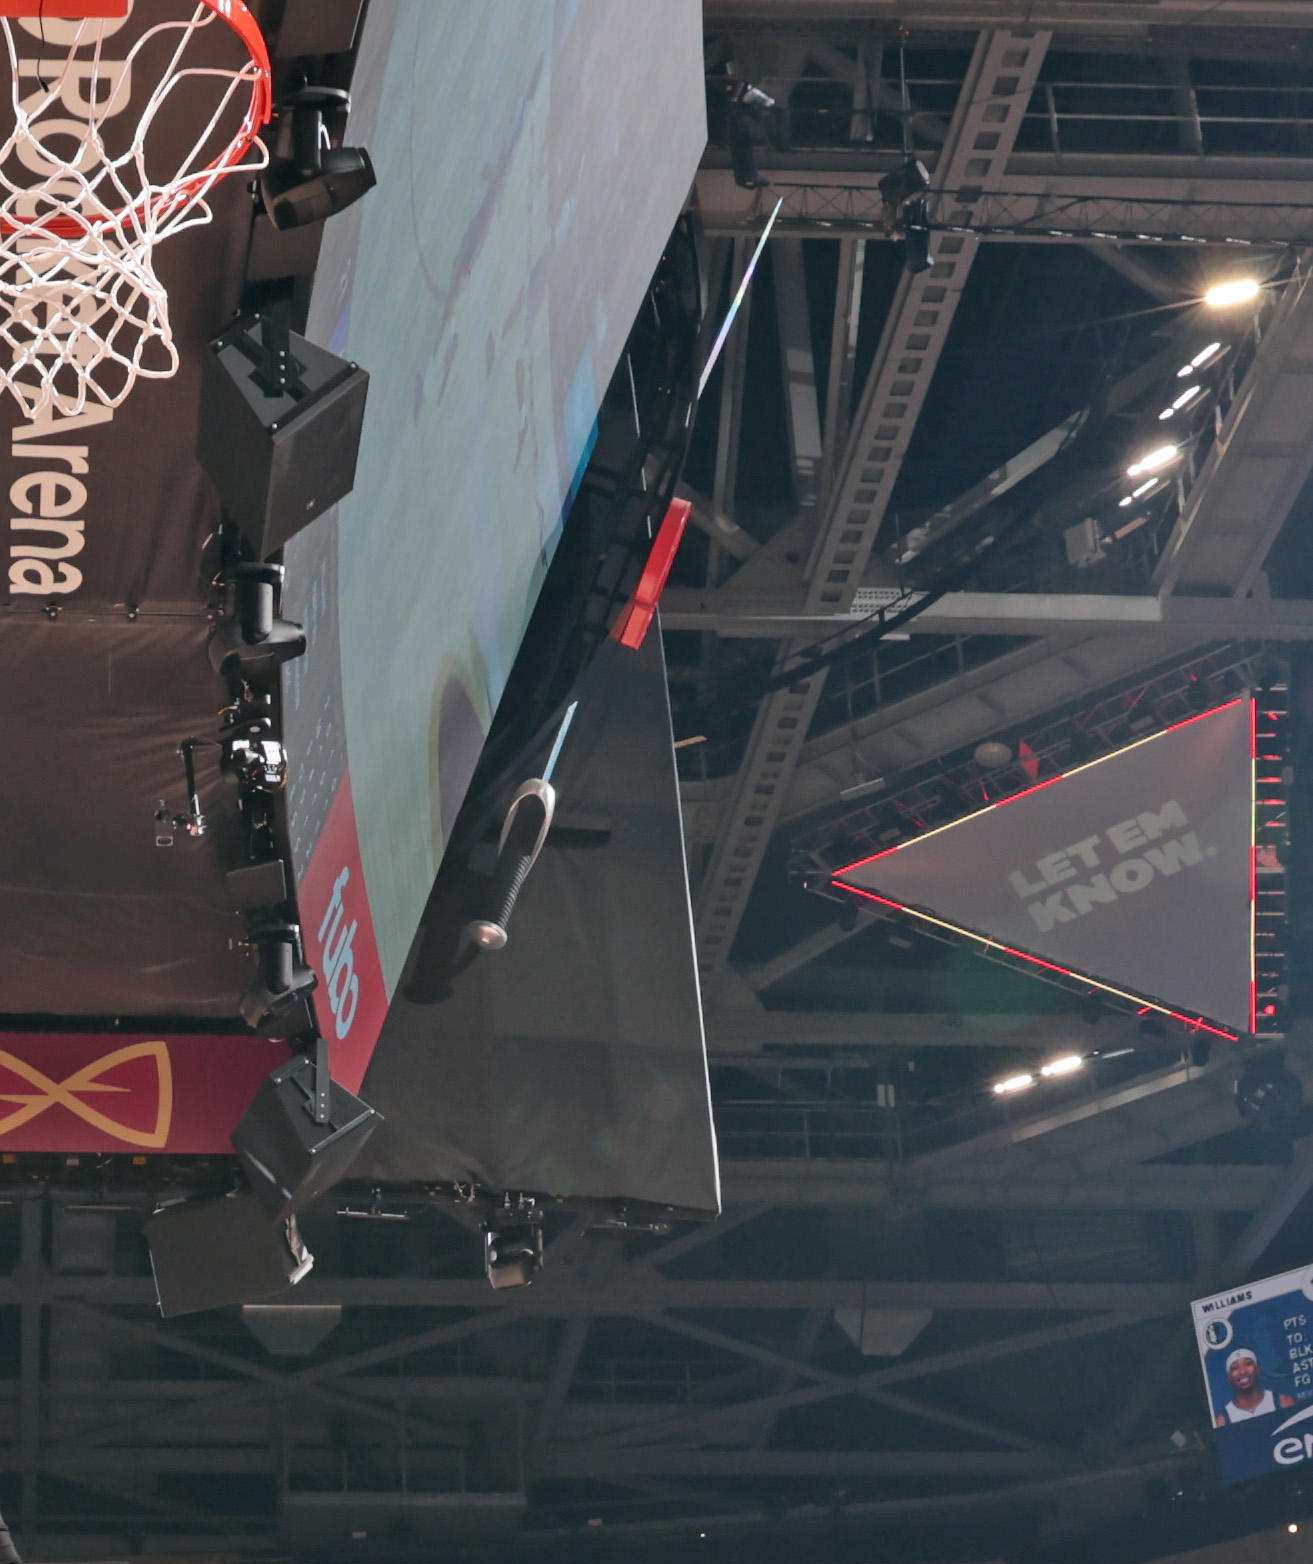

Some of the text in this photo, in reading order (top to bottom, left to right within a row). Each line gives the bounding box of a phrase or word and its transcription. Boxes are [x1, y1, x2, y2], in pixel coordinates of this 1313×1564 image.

[8, 385, 114, 594] Arena
[1009, 800, 1188, 900] LET EM
[318, 866, 359, 1039] fubo
[1202, 1291, 1252, 1313] WILLIAMS
[1283, 1315, 1307, 1330] PTS
[1294, 1373, 1311, 1387] FG
